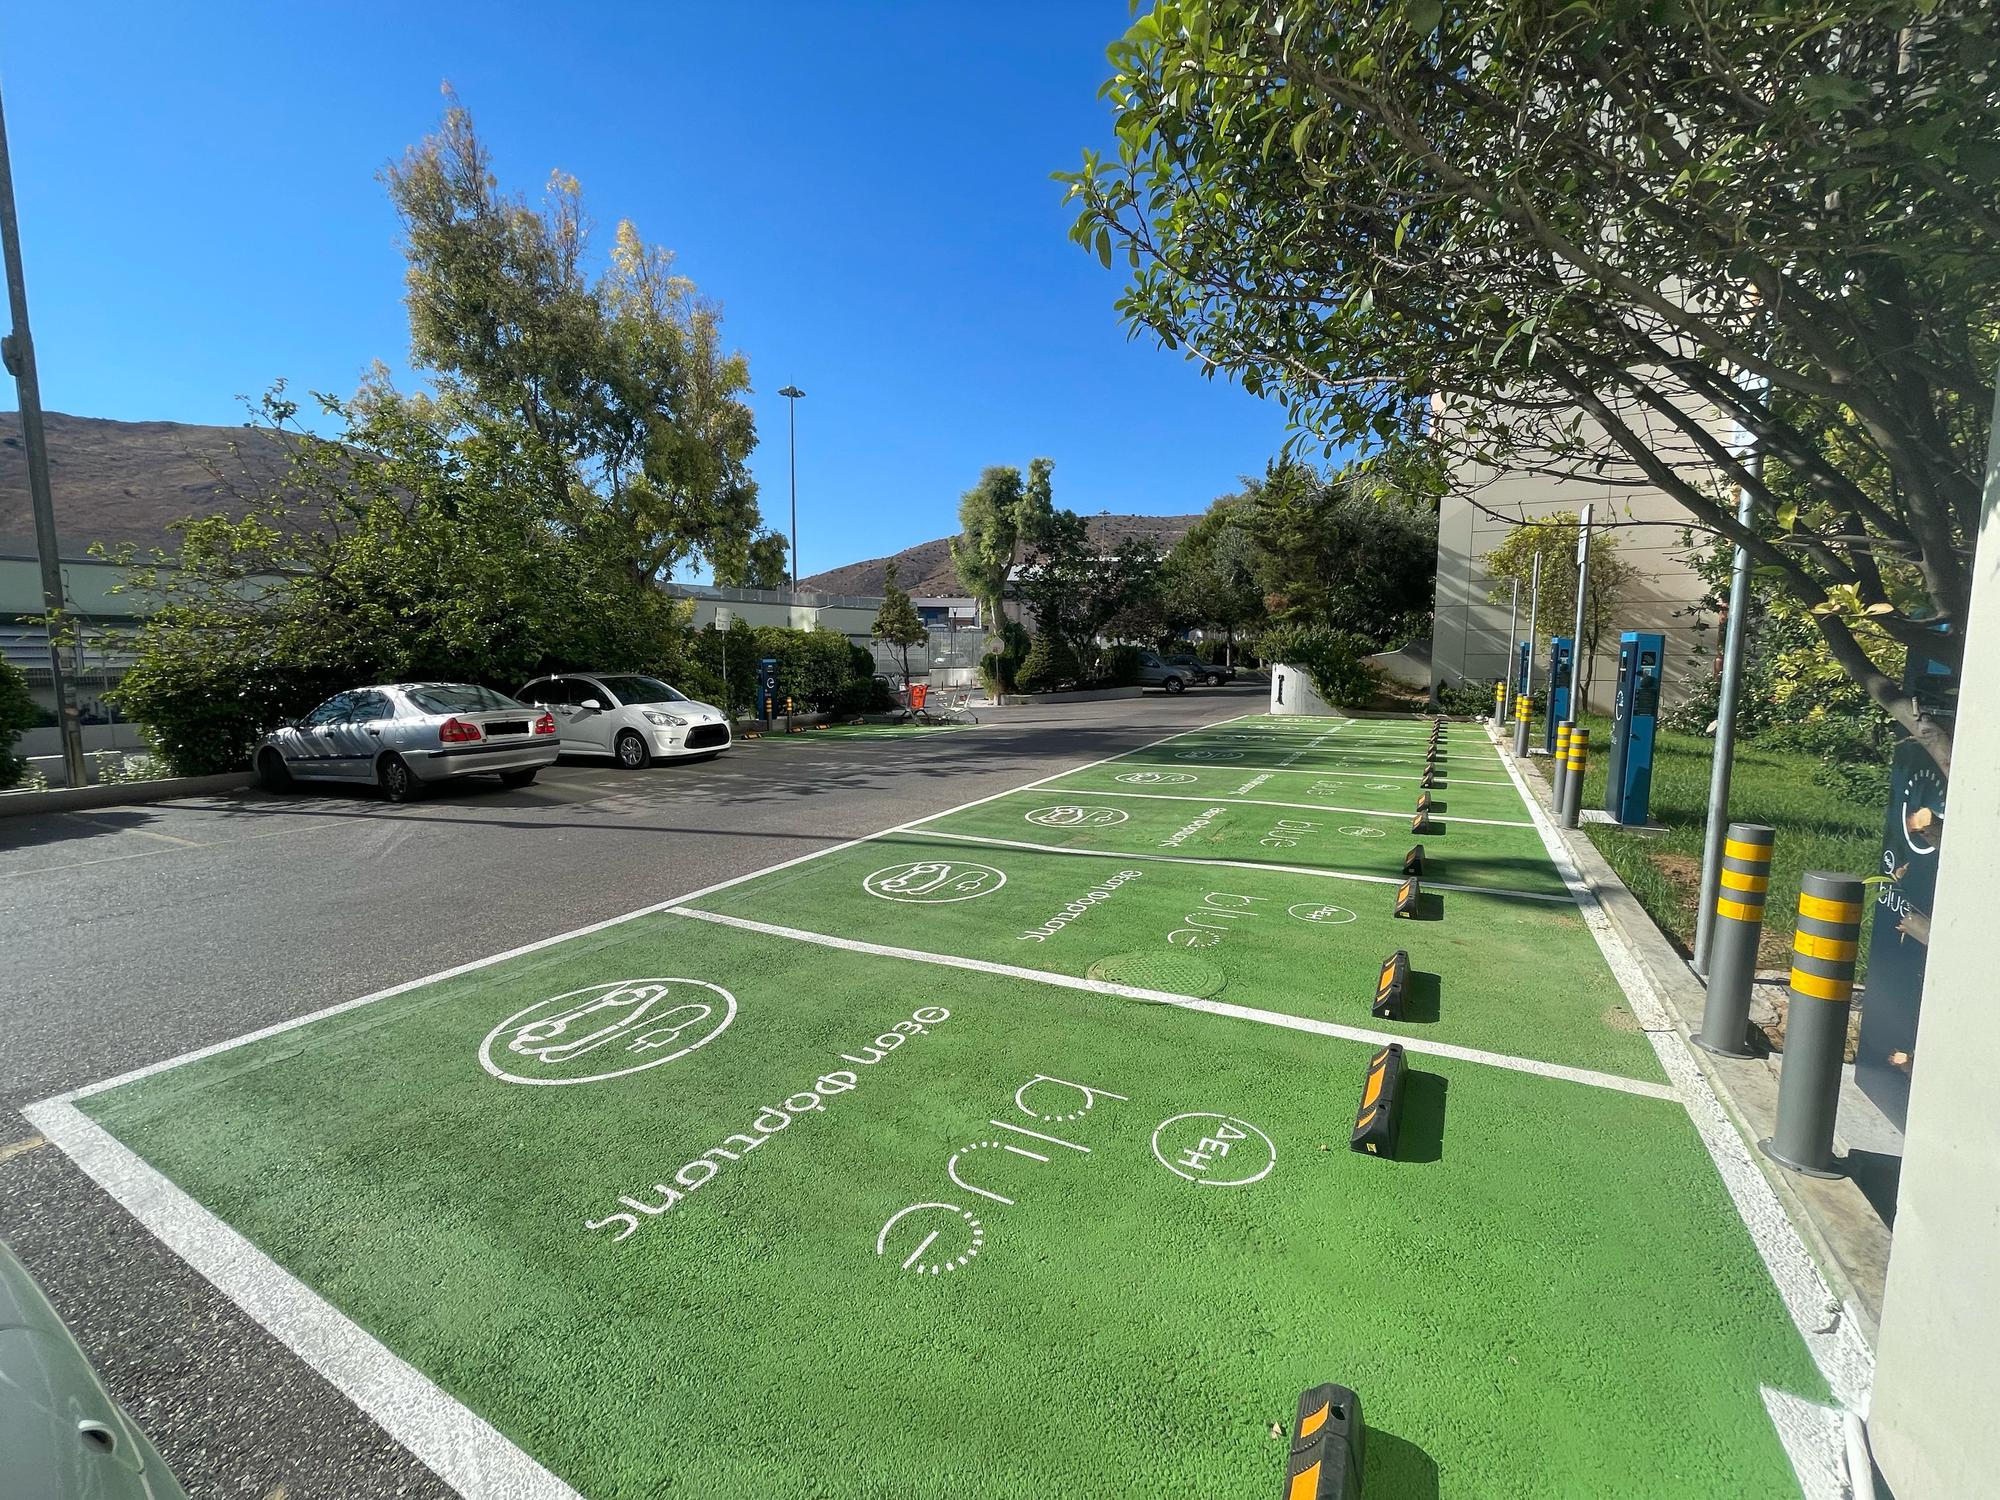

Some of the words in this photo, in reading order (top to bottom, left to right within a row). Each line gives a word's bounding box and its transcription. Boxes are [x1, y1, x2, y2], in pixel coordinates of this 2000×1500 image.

[1167, 891, 1269, 947] blue
[876, 1073, 1128, 1274] blue
[1177, 1122, 1247, 1171] ΔΕΗ
